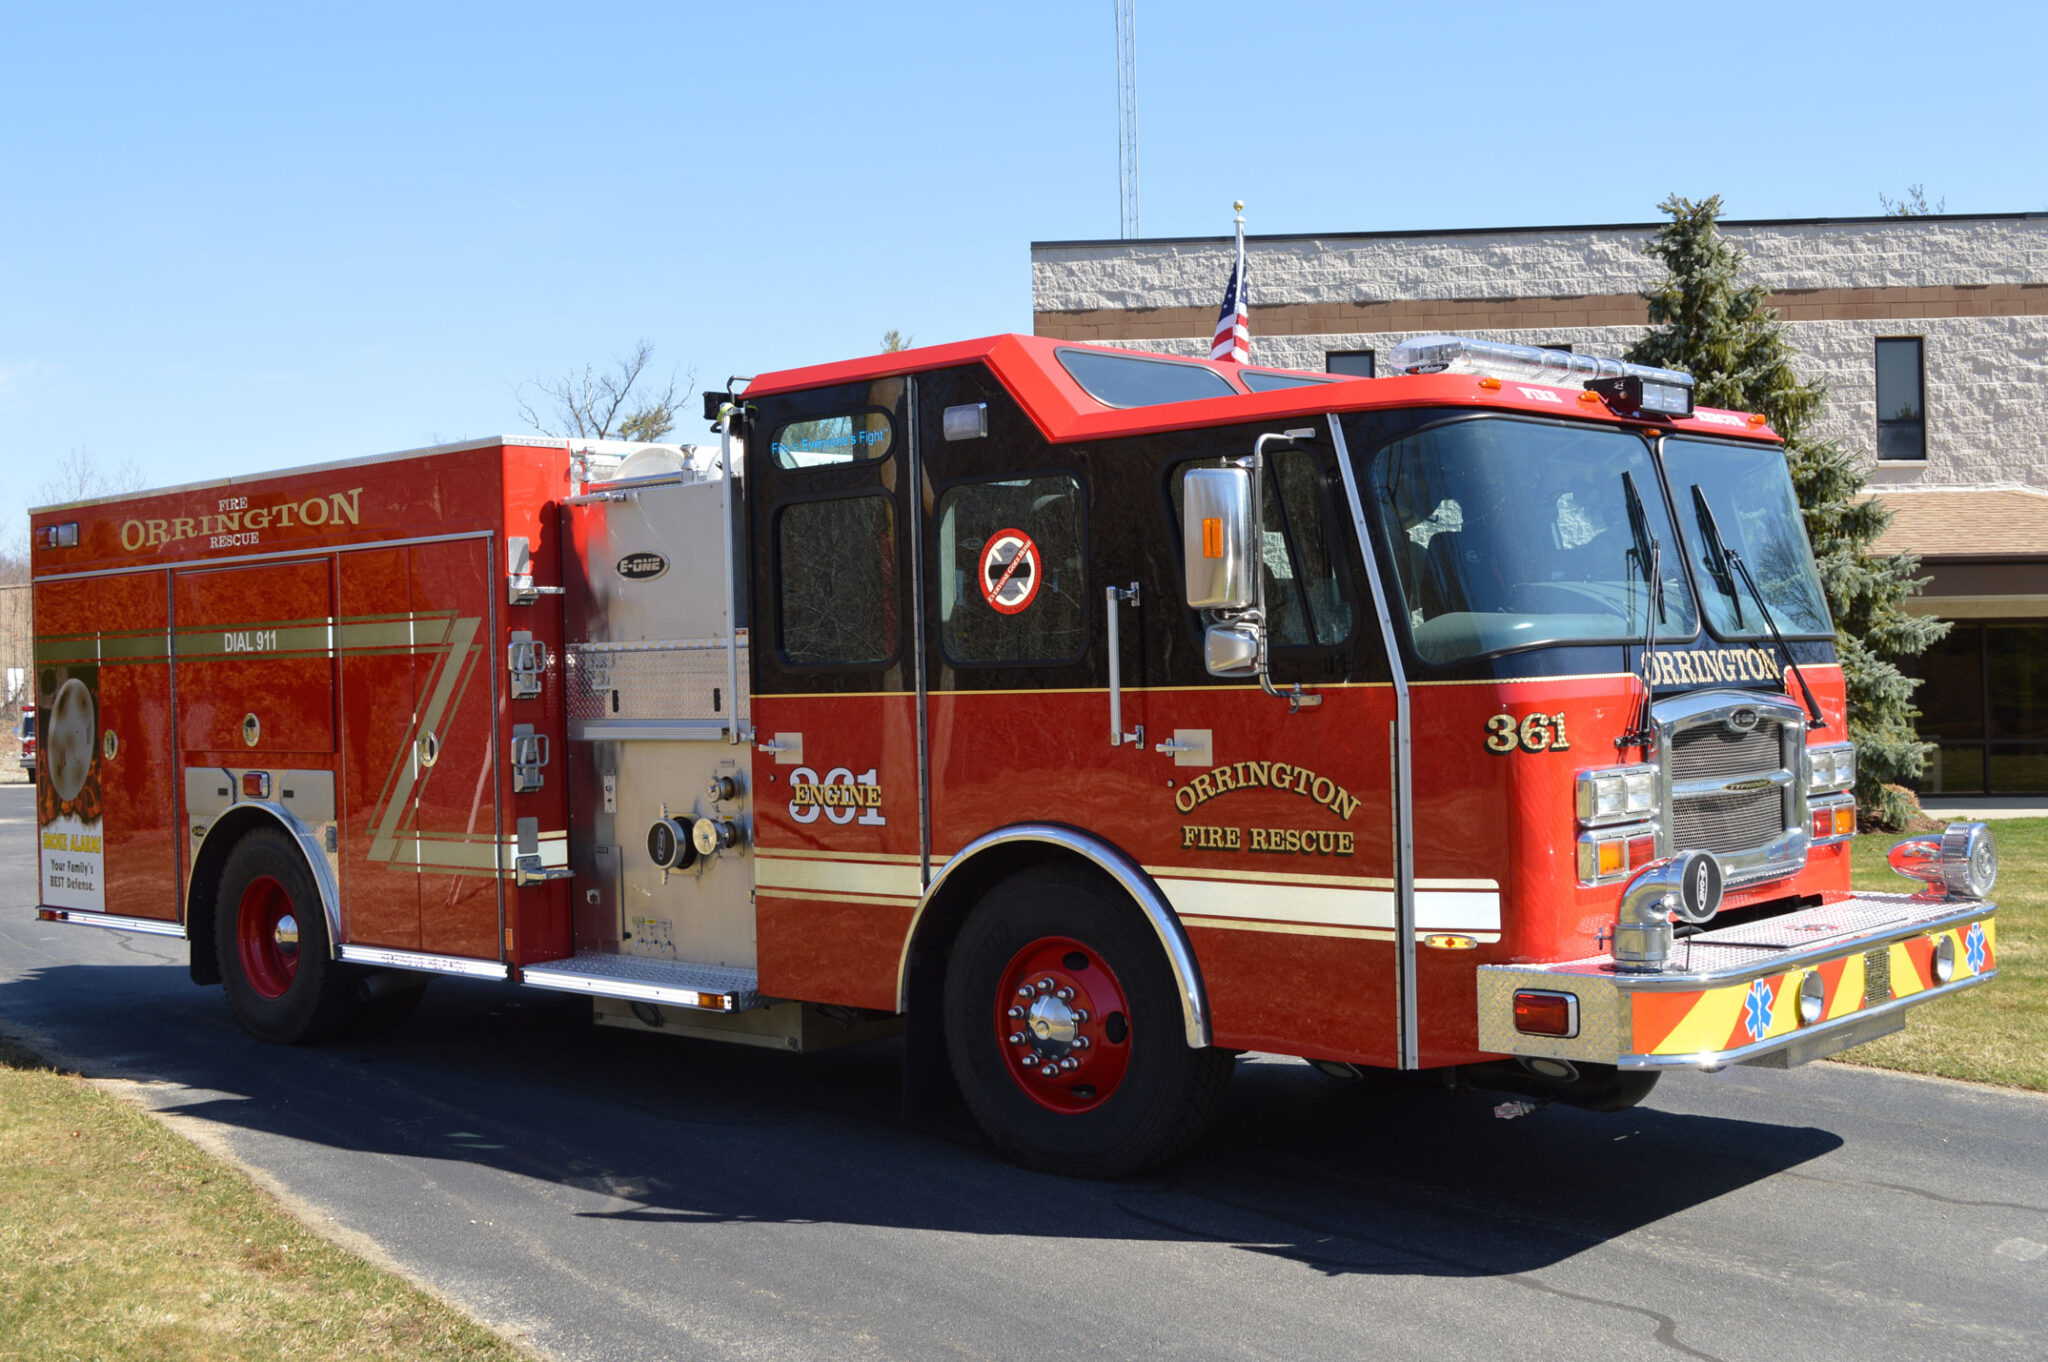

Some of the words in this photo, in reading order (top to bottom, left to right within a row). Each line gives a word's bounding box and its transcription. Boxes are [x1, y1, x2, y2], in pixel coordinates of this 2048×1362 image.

[1517, 386, 1563, 403] FIRE
[801, 432, 857, 451] Everyone's
[218, 497, 248, 512] FIRE
[121, 487, 364, 551] ORRINGTON
[210, 532, 260, 549] RESCUE
[620, 557, 661, 573] E-ONE
[224, 632, 254, 652] DIAL
[256, 630, 277, 651] 911
[1641, 648, 1781, 686] ORRINGTON
[1485, 711, 1571, 755] 361
[788, 766, 886, 827] 361
[793, 783, 882, 808] ENGINE
[1175, 761, 1362, 822] ORRINGTON
[1182, 825, 1241, 850] FIRE
[1249, 828, 1355, 856] RESCUE
[50, 859, 66, 872] Your
[67, 860, 94, 876] Family's
[50, 875, 65, 888] BEST
